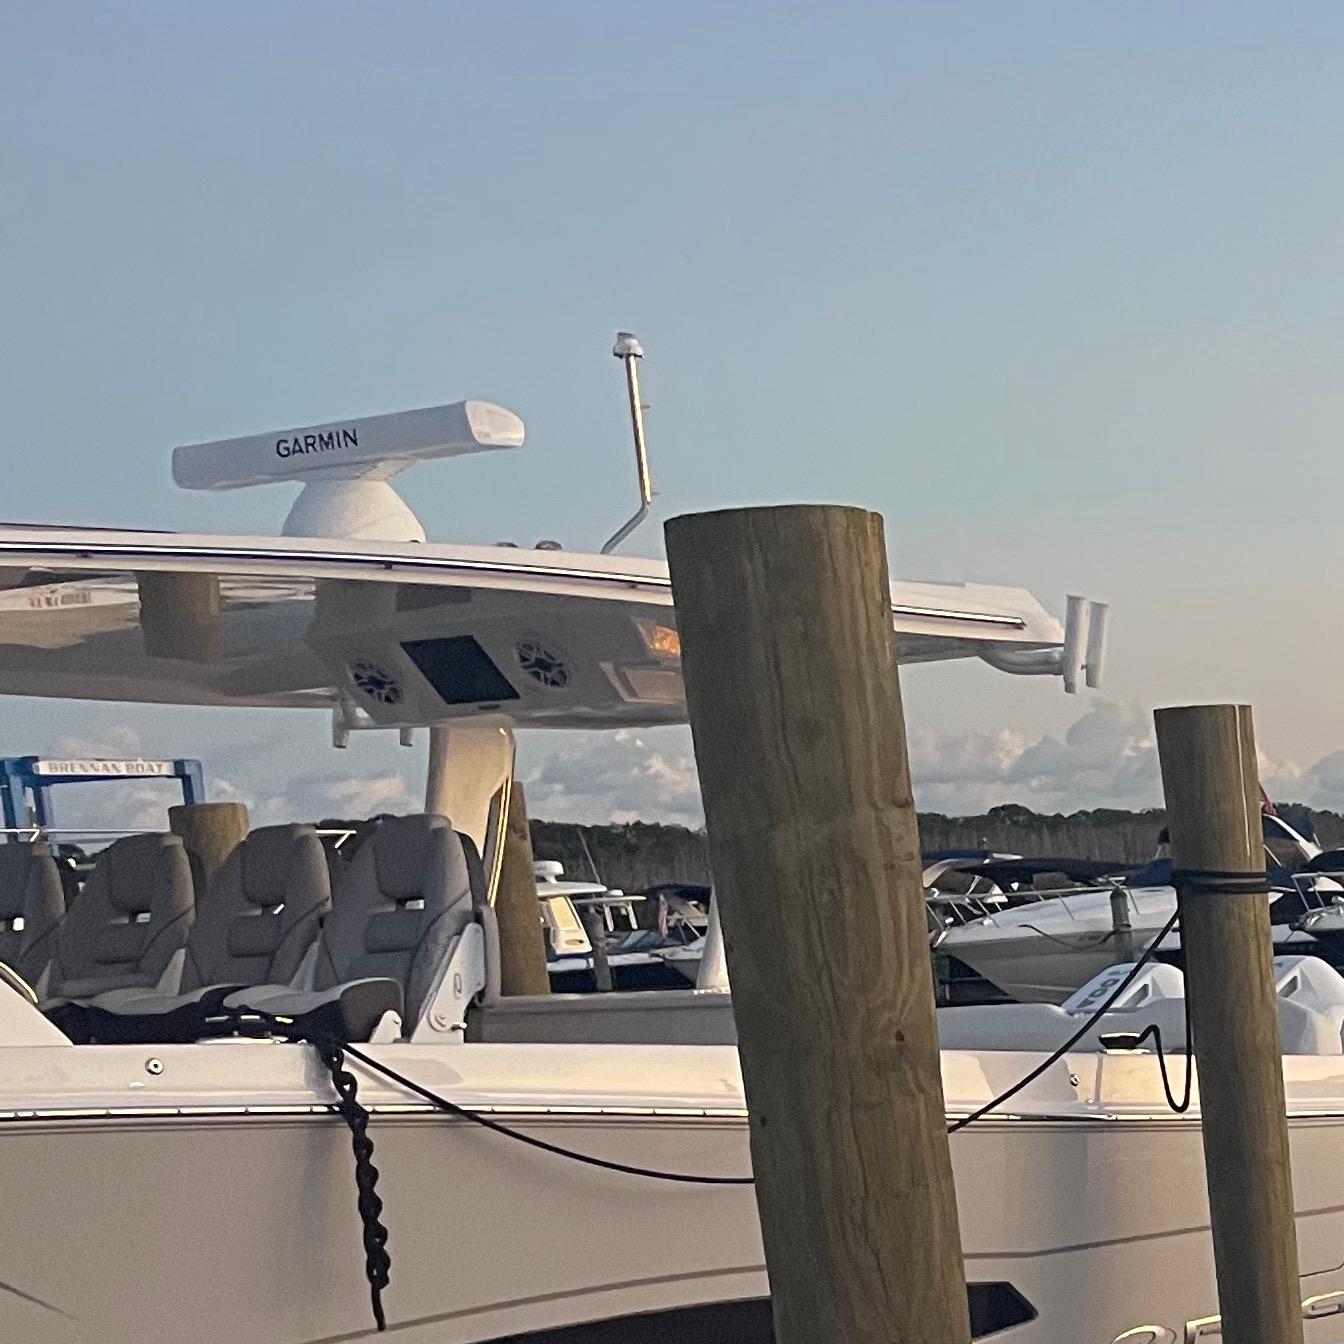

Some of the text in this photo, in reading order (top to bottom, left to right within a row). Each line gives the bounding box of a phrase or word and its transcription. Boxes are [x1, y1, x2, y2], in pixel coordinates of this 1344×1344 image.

[276, 428, 358, 458] GARMIN
[48, 762, 163, 774] BRENNAN BOAT
